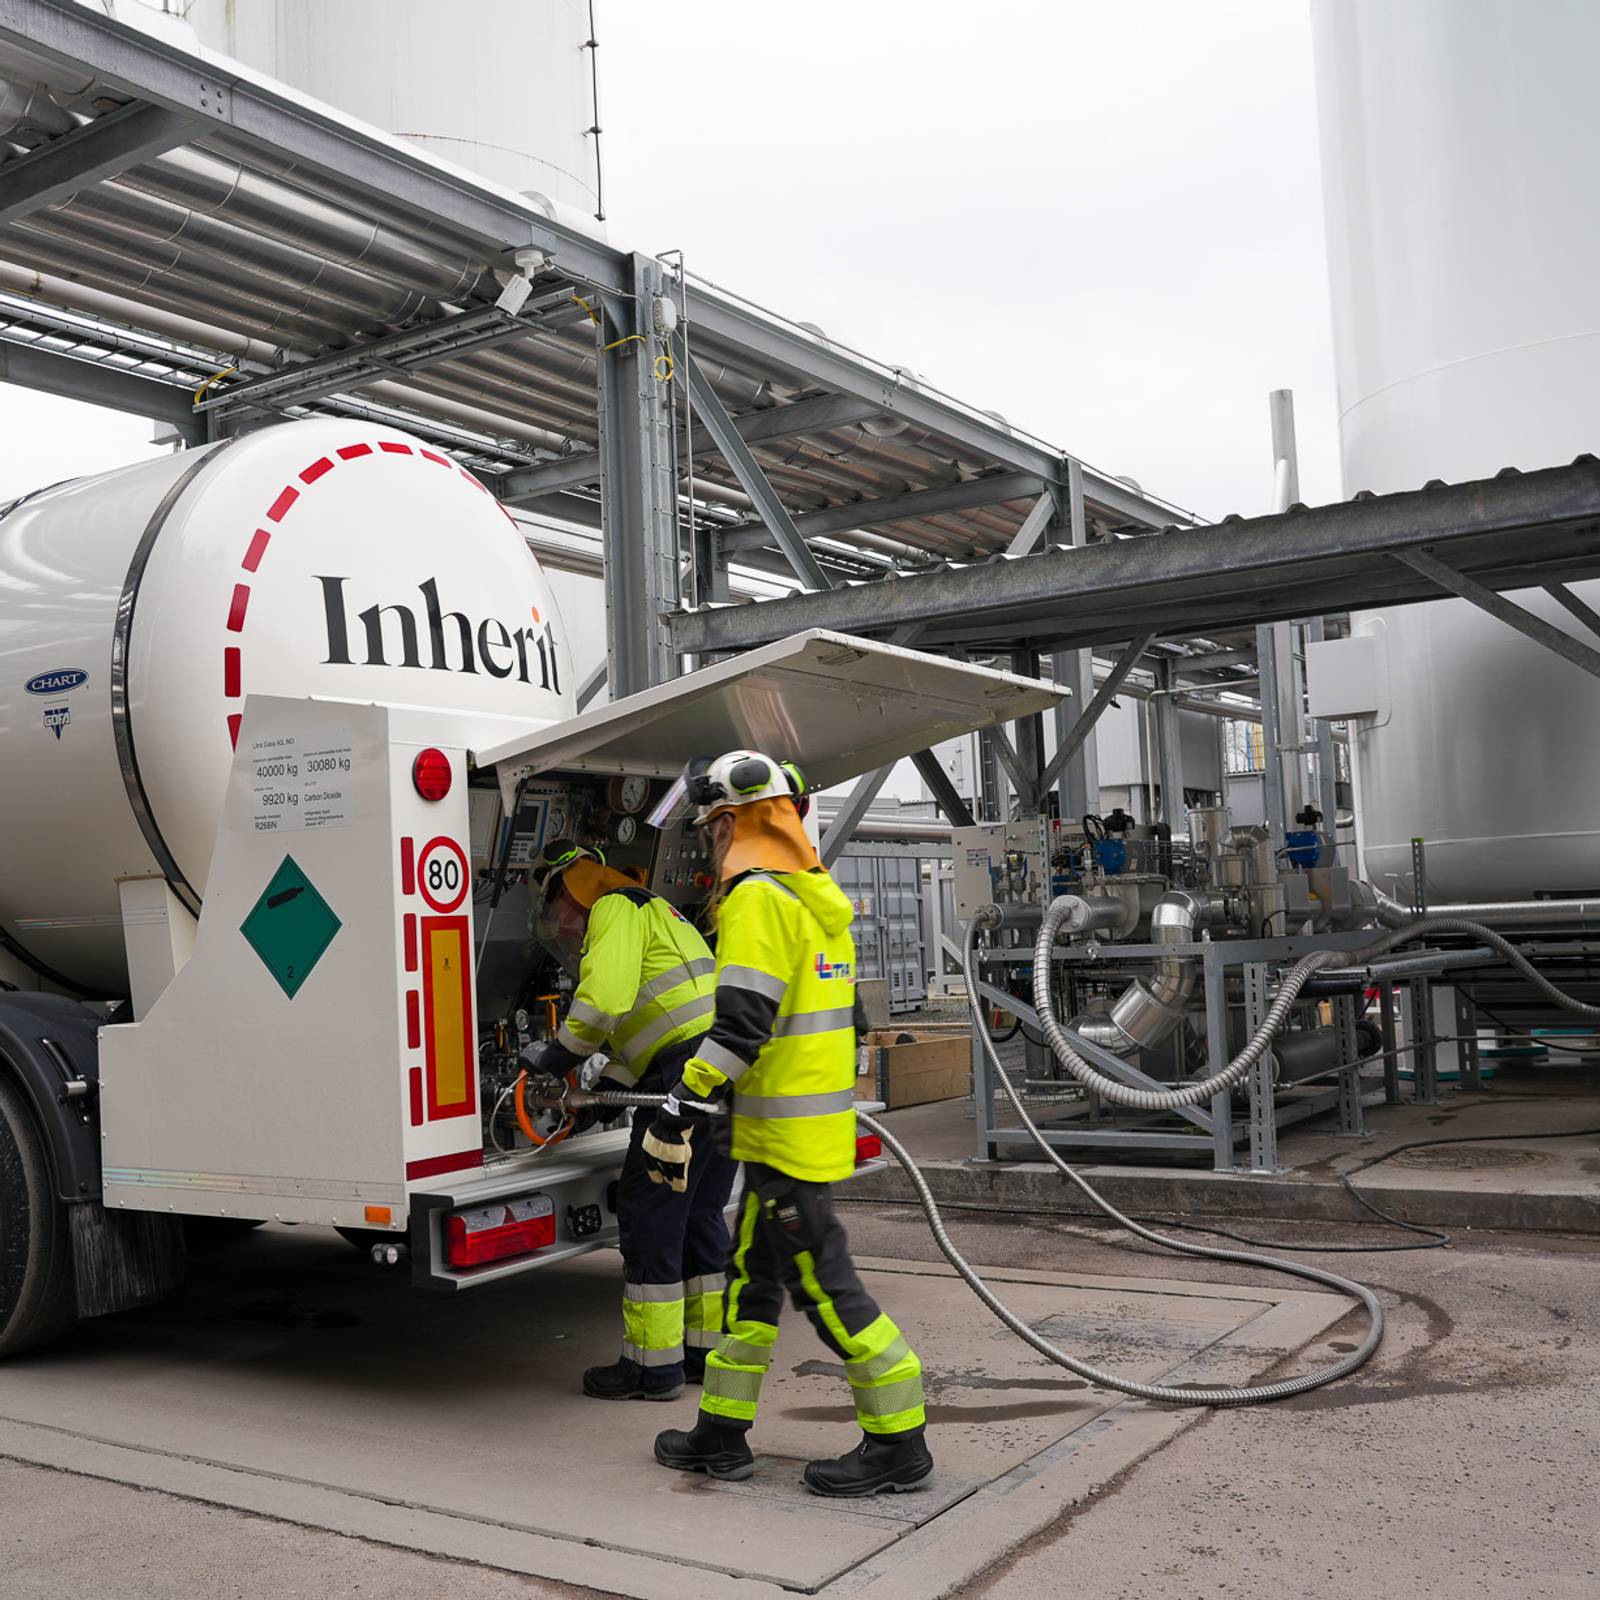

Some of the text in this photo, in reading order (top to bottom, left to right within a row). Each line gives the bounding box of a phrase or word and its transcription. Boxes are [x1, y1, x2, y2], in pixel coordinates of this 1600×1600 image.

[310, 575, 562, 695] Inherit
[32, 674, 77, 690] CHART
[257, 763, 298, 778] 40000 kg
[307, 758, 336, 773] 30080
[339, 757, 350, 771] kg
[262, 792, 298, 806] 9920 kg
[429, 859, 458, 890] 80
[287, 966, 294, 978] 2
